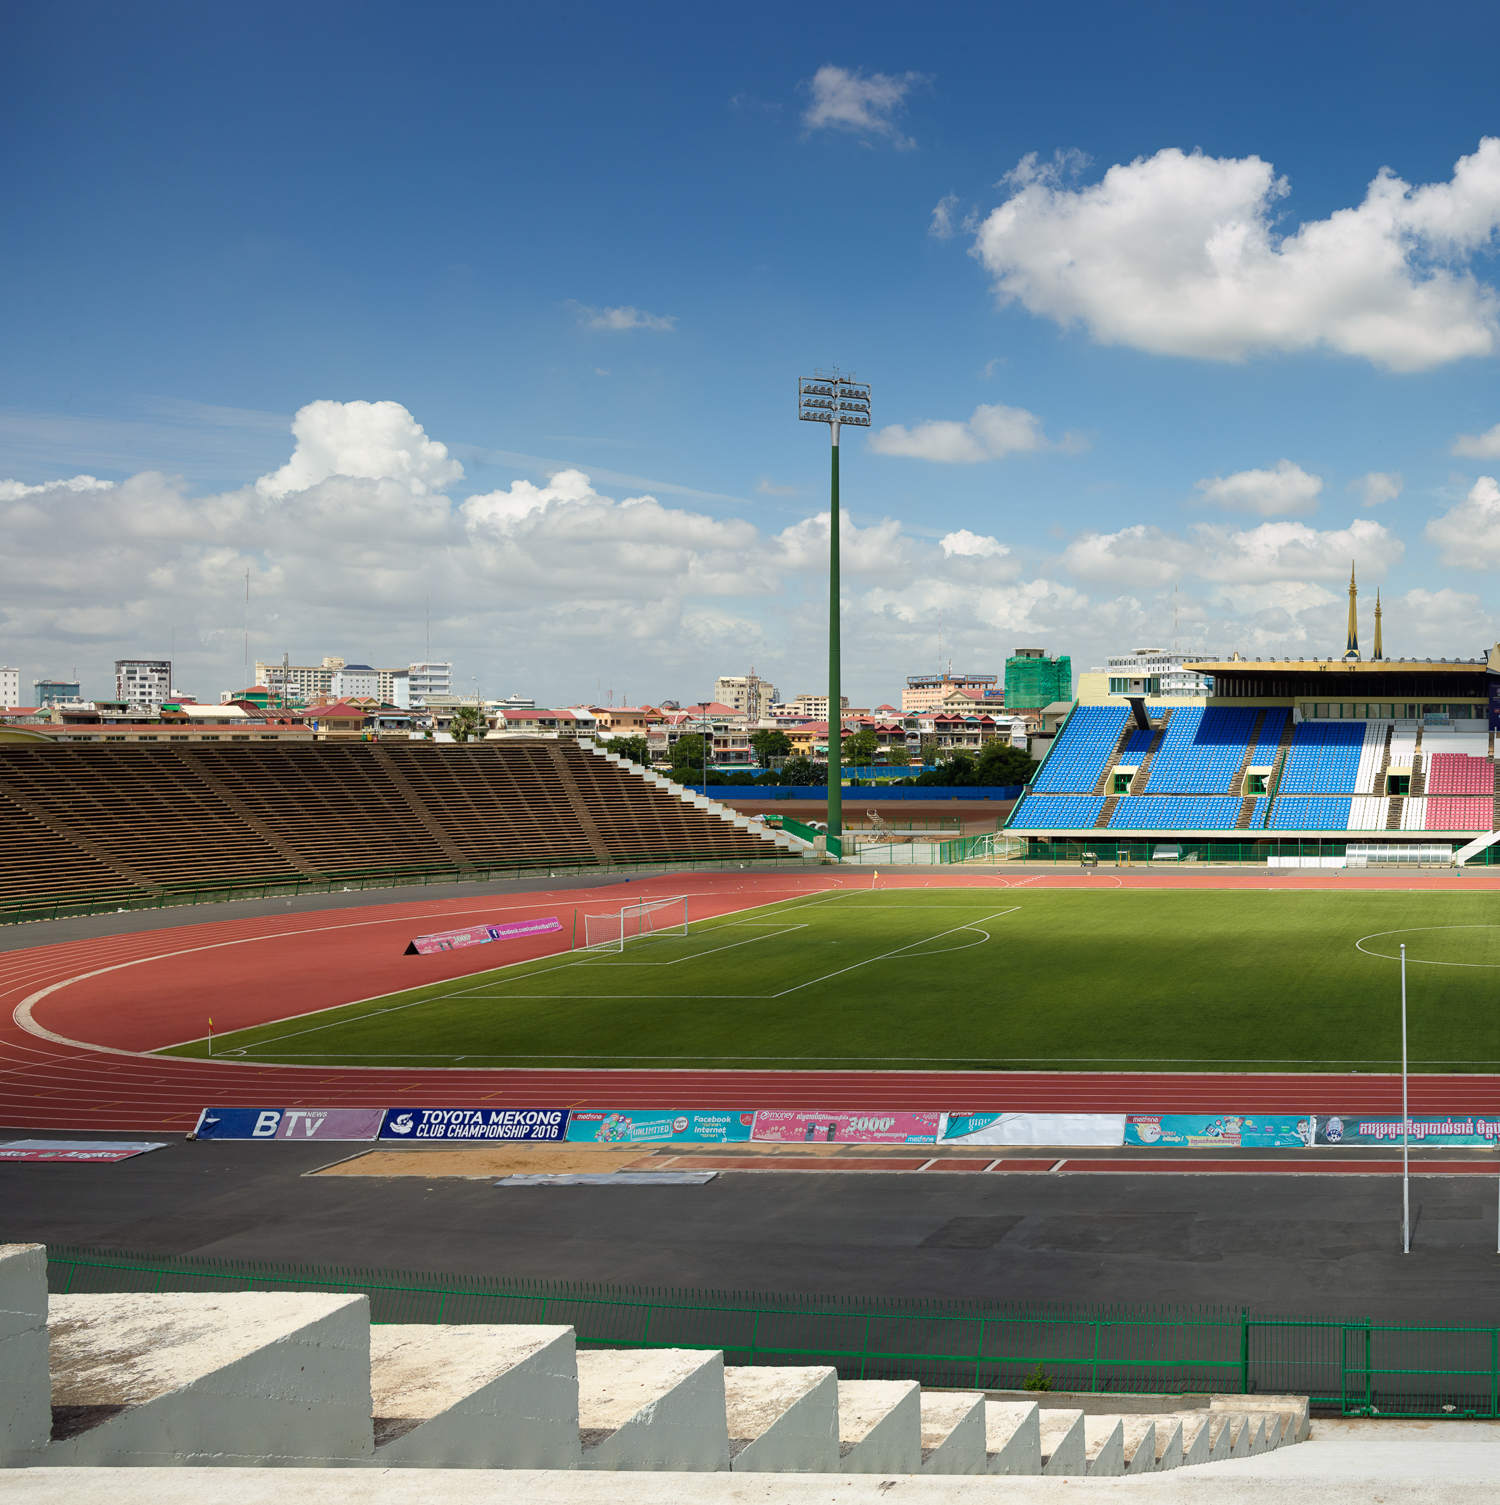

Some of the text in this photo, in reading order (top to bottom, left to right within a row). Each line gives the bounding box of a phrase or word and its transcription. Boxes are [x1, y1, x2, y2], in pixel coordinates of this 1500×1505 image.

[421, 1110, 562, 1125] TOYOTA MEKONG
[416, 1124, 559, 1138] CLUB CHAMPIONSHIP 2016
[633, 1125, 670, 1136] UNLIMITED
[694, 1126, 727, 1134] Internet
[58, 1150, 128, 1159] Angkor
